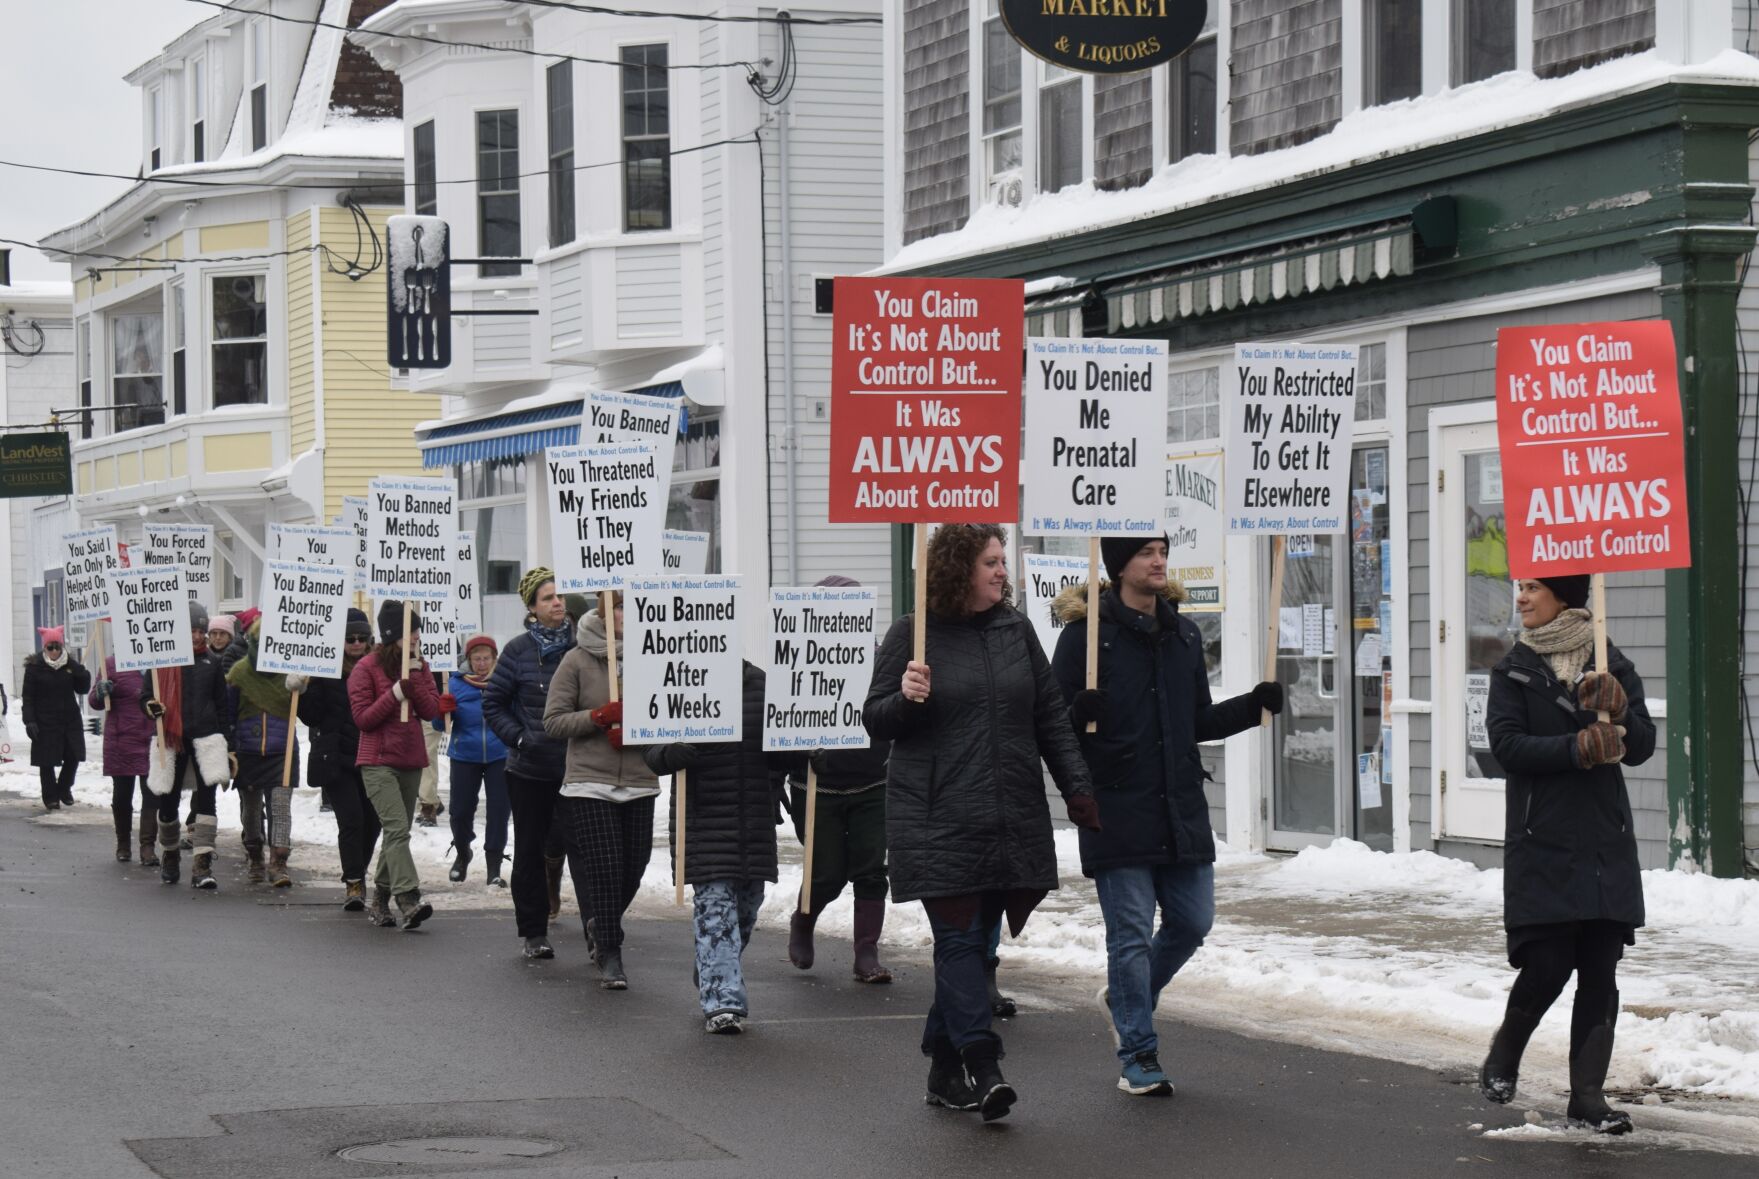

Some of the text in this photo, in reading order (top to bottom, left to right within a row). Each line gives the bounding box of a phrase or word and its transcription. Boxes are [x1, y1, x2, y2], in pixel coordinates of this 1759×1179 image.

[1041, 0, 1170, 17] MARKET
[1055, 35, 1161, 64] & LIQUORS
[875, 290, 977, 318] You Claim
[850, 324, 1000, 351] It's Not About
[1034, 343, 1162, 355] You Claim It's Not About Control But...
[1531, 335, 1632, 366] You Claim
[859, 357, 996, 385] Control But...
[1040, 360, 1151, 392] You Denied
[1239, 367, 1354, 396] You Restricted
[1510, 368, 1656, 402] It's Not About
[591, 405, 670, 434] You Banned
[897, 401, 960, 427] It Was
[1080, 399, 1109, 429] Me
[1244, 404, 1341, 439] My Ability
[1522, 402, 1658, 438] Control But...
[1, 445, 64, 459] LandVest
[852, 435, 1003, 473] ALWAYS
[1053, 437, 1136, 467] Prenatal
[1252, 441, 1330, 470] To Get It
[1563, 447, 1627, 475] It Was
[549, 456, 654, 484] You Threatened
[855, 481, 999, 508] About Control
[1072, 475, 1116, 505] Care
[1176, 464, 1216, 510] MARKET
[1244, 478, 1330, 507] Elsewhere
[377, 493, 451, 514] You Banned
[559, 486, 647, 516] My Friends
[1526, 479, 1670, 529] ALWAYS
[386, 517, 439, 537] Methods
[577, 516, 632, 544] If They
[1033, 518, 1154, 532] It Was Always About Control
[1231, 517, 1338, 530] It Was Always About Control
[69, 537, 110, 557] You Said I
[150, 534, 205, 548] You Forced
[308, 538, 326, 553] You
[379, 540, 445, 561] To Prevent
[1290, 534, 1311, 552] OPEN
[1532, 525, 1670, 562] About Control
[66, 562, 82, 576] Can
[85, 557, 102, 576] Only
[106, 555, 116, 569] Be
[145, 551, 173, 564] Women
[189, 552, 211, 568] Carry
[581, 543, 634, 572] Helped
[663, 549, 680, 568] You
[66, 575, 93, 598] Helped
[116, 575, 178, 596] You Forced
[274, 573, 344, 596] You Banned
[372, 564, 451, 585] Implantation
[631, 579, 739, 590] You Claim It's Not About Control But...
[1032, 574, 1055, 598] You
[1179, 567, 1213, 581] BUSINESS
[68, 596, 89, 614] Brink
[92, 593, 100, 607] Of
[459, 584, 471, 599] Of
[1191, 589, 1217, 601] SUPPORT
[127, 598, 172, 614] Children
[278, 594, 334, 624] Aborting
[635, 595, 734, 622] You Banned
[126, 618, 174, 634] To Carry
[281, 614, 324, 639] Ectopic
[773, 608, 873, 633] You Threatened
[130, 637, 175, 654] To Term
[265, 634, 335, 660] Pregnancies
[642, 629, 726, 654] Abortions
[138, 660, 154, 670] Always
[155, 659, 170, 668] About
[171, 657, 189, 667] Control
[775, 640, 864, 670] My Doctors
[664, 661, 708, 686] After
[791, 669, 845, 701] If They
[649, 693, 720, 719] 6 Weeks
[767, 703, 837, 728] Performed
[631, 726, 733, 738] It Was Always About Control
[771, 735, 864, 750] It Was Always About Control
